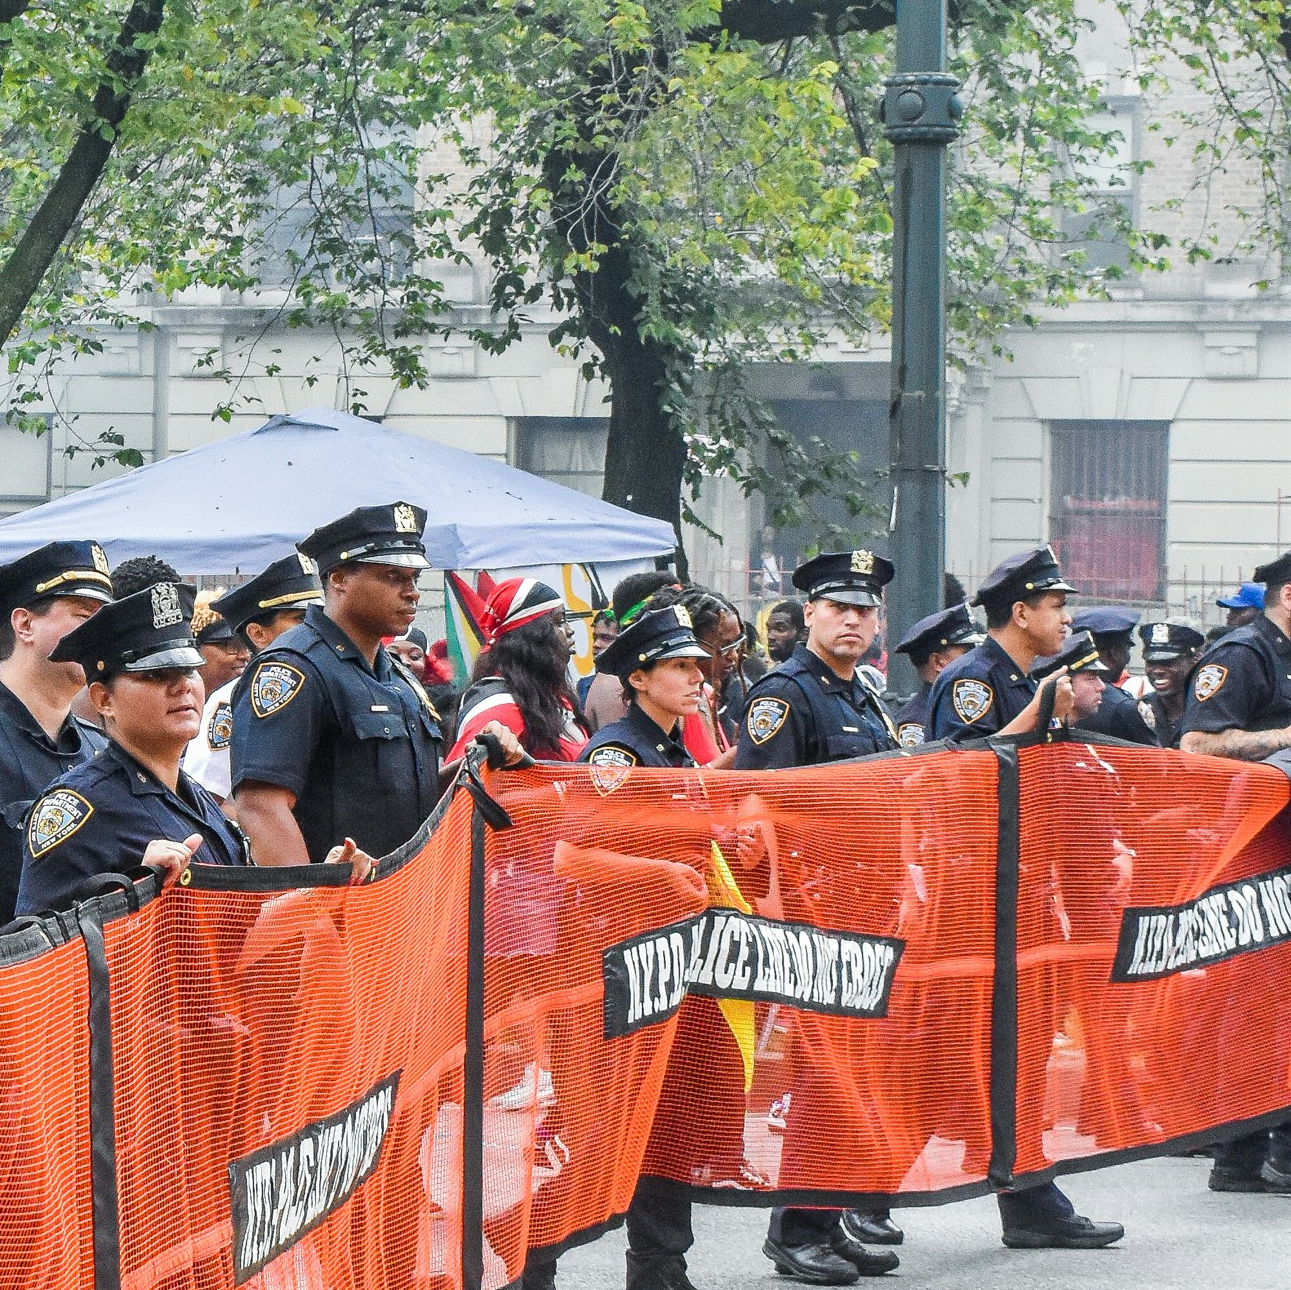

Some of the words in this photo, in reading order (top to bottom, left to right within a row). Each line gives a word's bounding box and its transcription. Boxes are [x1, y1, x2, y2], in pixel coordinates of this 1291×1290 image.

[269, 666, 292, 677] POLICE
[55, 793, 80, 806] POLICE
[56, 822, 77, 838] YORK
[1227, 884, 1264, 946] DO
